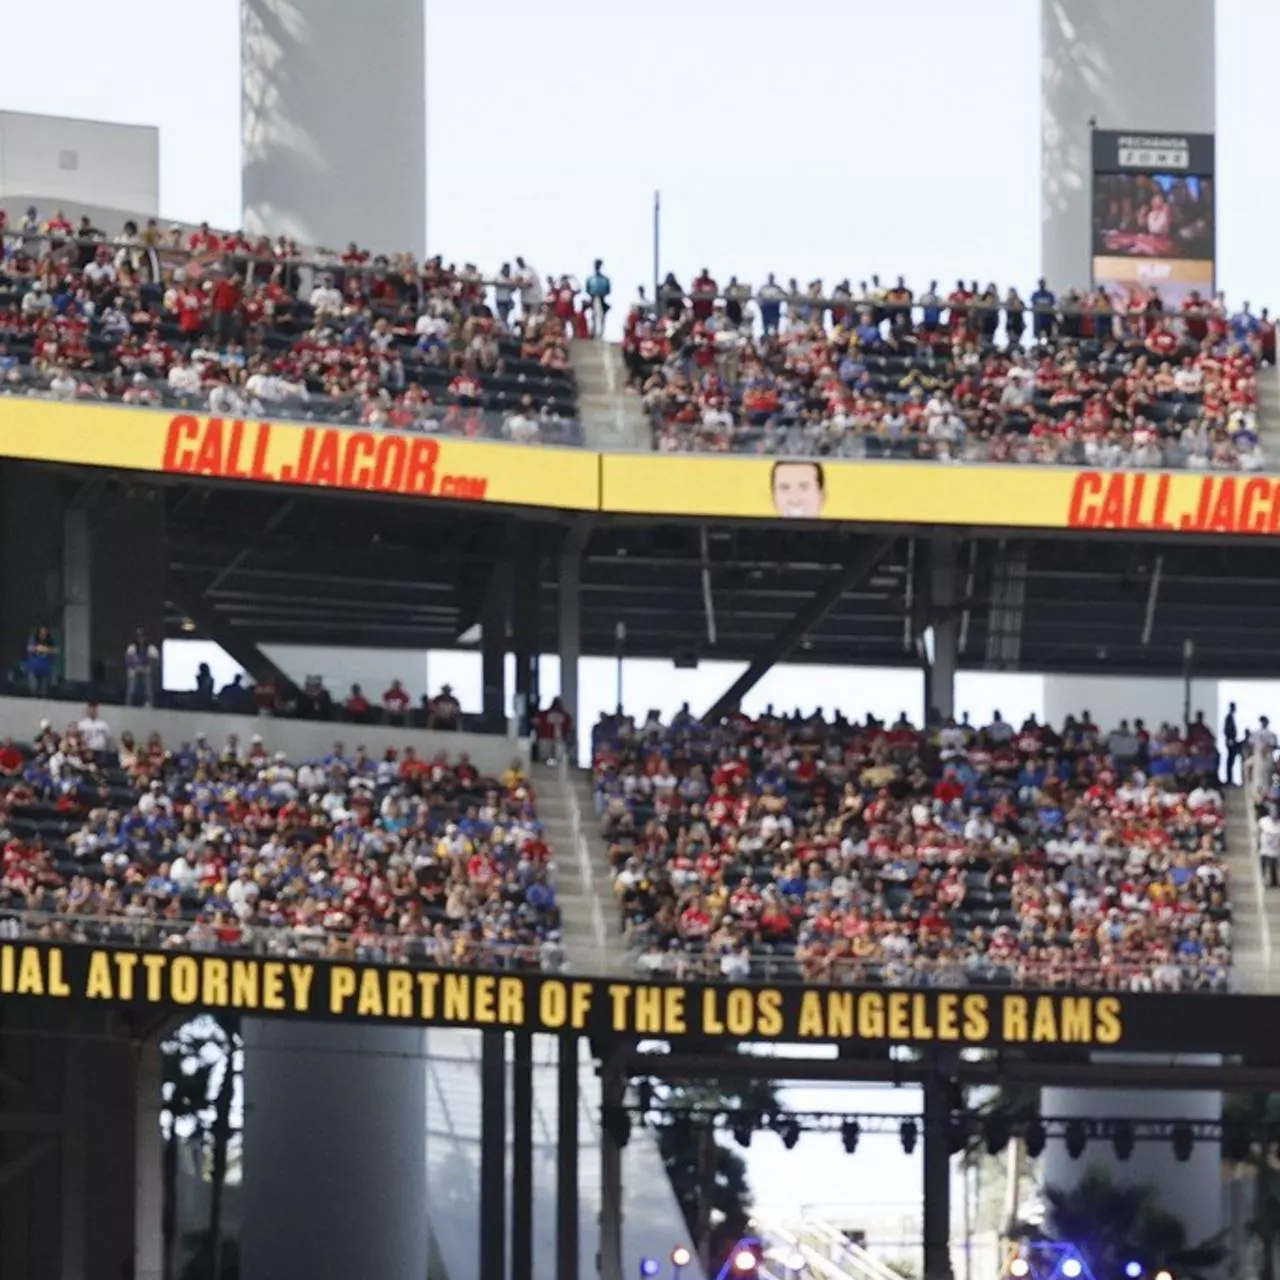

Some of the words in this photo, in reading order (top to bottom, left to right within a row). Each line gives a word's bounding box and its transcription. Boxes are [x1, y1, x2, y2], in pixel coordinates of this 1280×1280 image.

[86, 951, 314, 1012] ATTORNEY
[330, 966, 525, 1025] PARTNER
[539, 980, 593, 1029] OF
[609, 985, 686, 1034] THE
[702, 988, 784, 1036] LOS
[798, 991, 990, 1041] ANGELES
[1002, 995, 1122, 1044] RAMS
